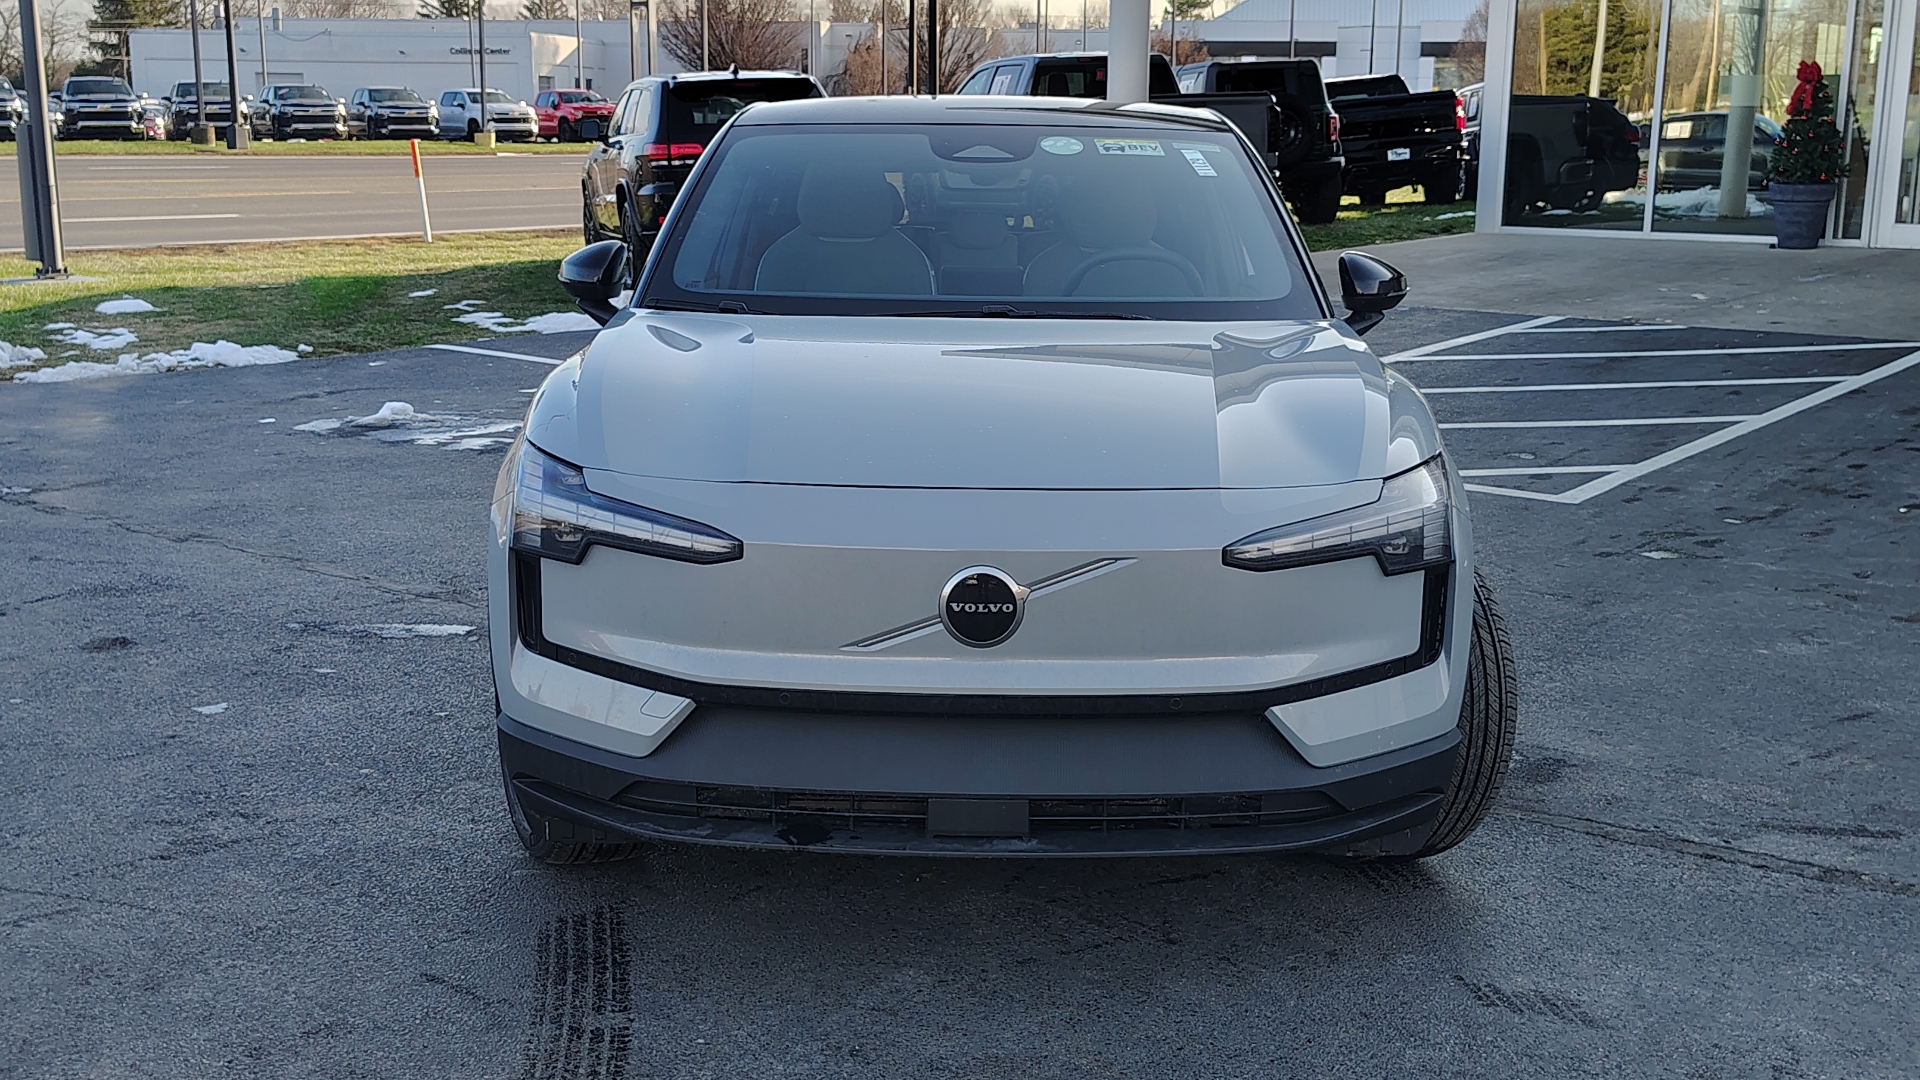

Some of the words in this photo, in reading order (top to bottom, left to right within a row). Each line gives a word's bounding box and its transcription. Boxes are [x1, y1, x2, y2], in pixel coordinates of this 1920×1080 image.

[450, 47, 482, 55] Collison
[485, 47, 510, 55] Center
[1127, 144, 1159, 152] BEV
[949, 602, 1014, 613] VOLVO
